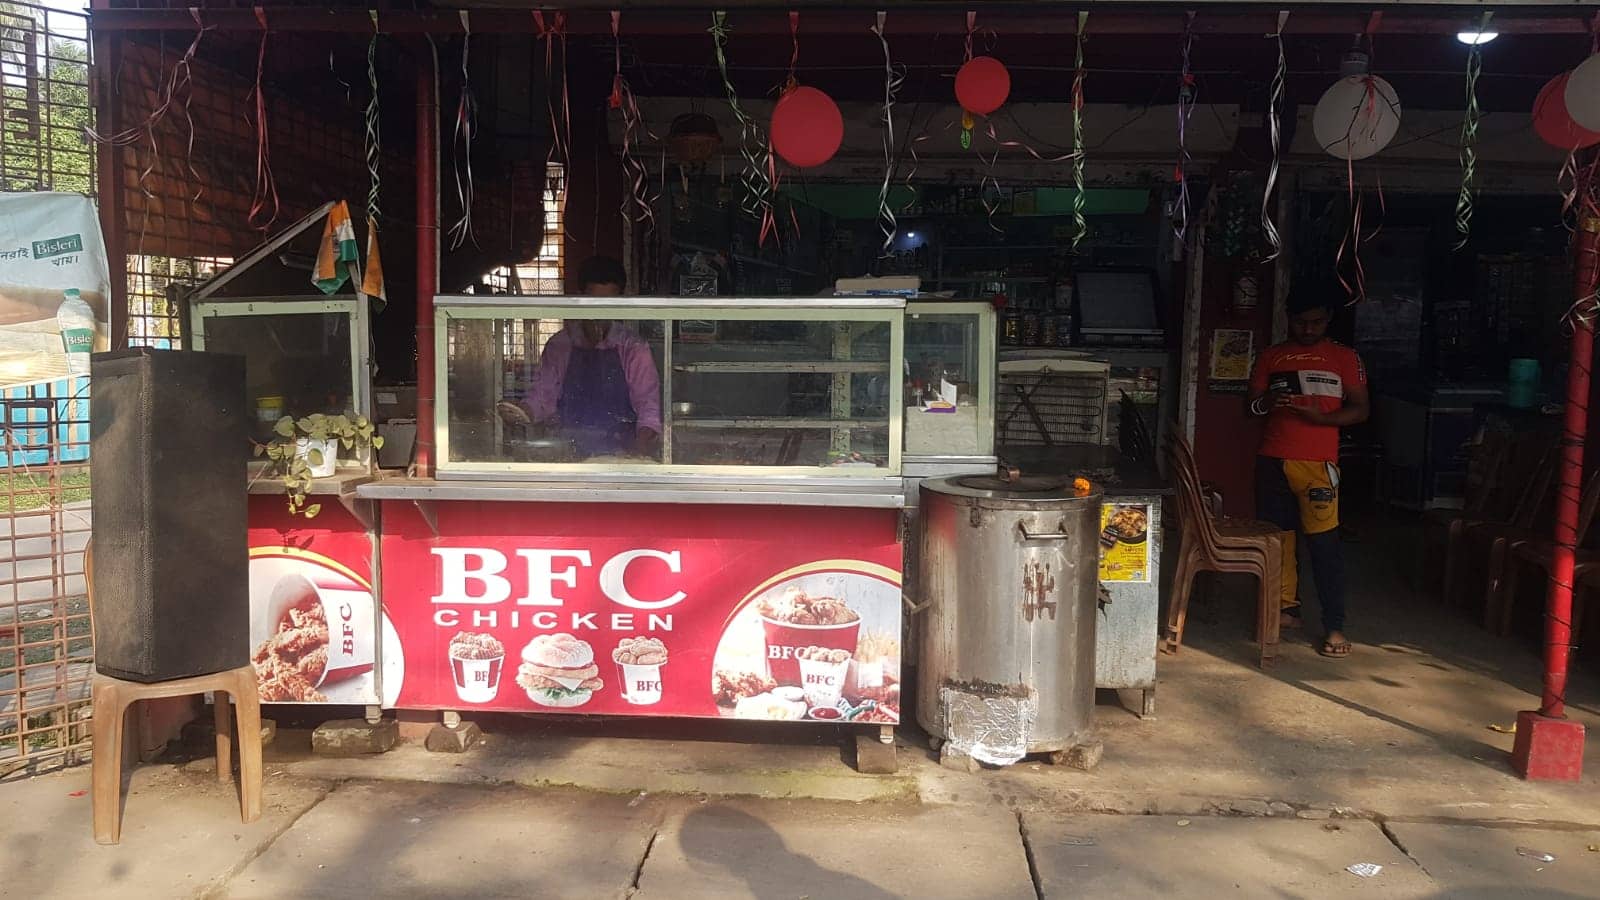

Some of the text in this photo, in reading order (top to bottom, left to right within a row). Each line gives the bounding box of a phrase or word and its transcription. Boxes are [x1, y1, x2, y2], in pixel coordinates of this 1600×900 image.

[36, 239, 77, 255] Bisleri
[430, 547, 688, 609] BFC
[338, 602, 354, 657] BFC
[433, 609, 673, 631] CHICKEN
[767, 645, 806, 660] BFC
[806, 674, 835, 686] BFC
